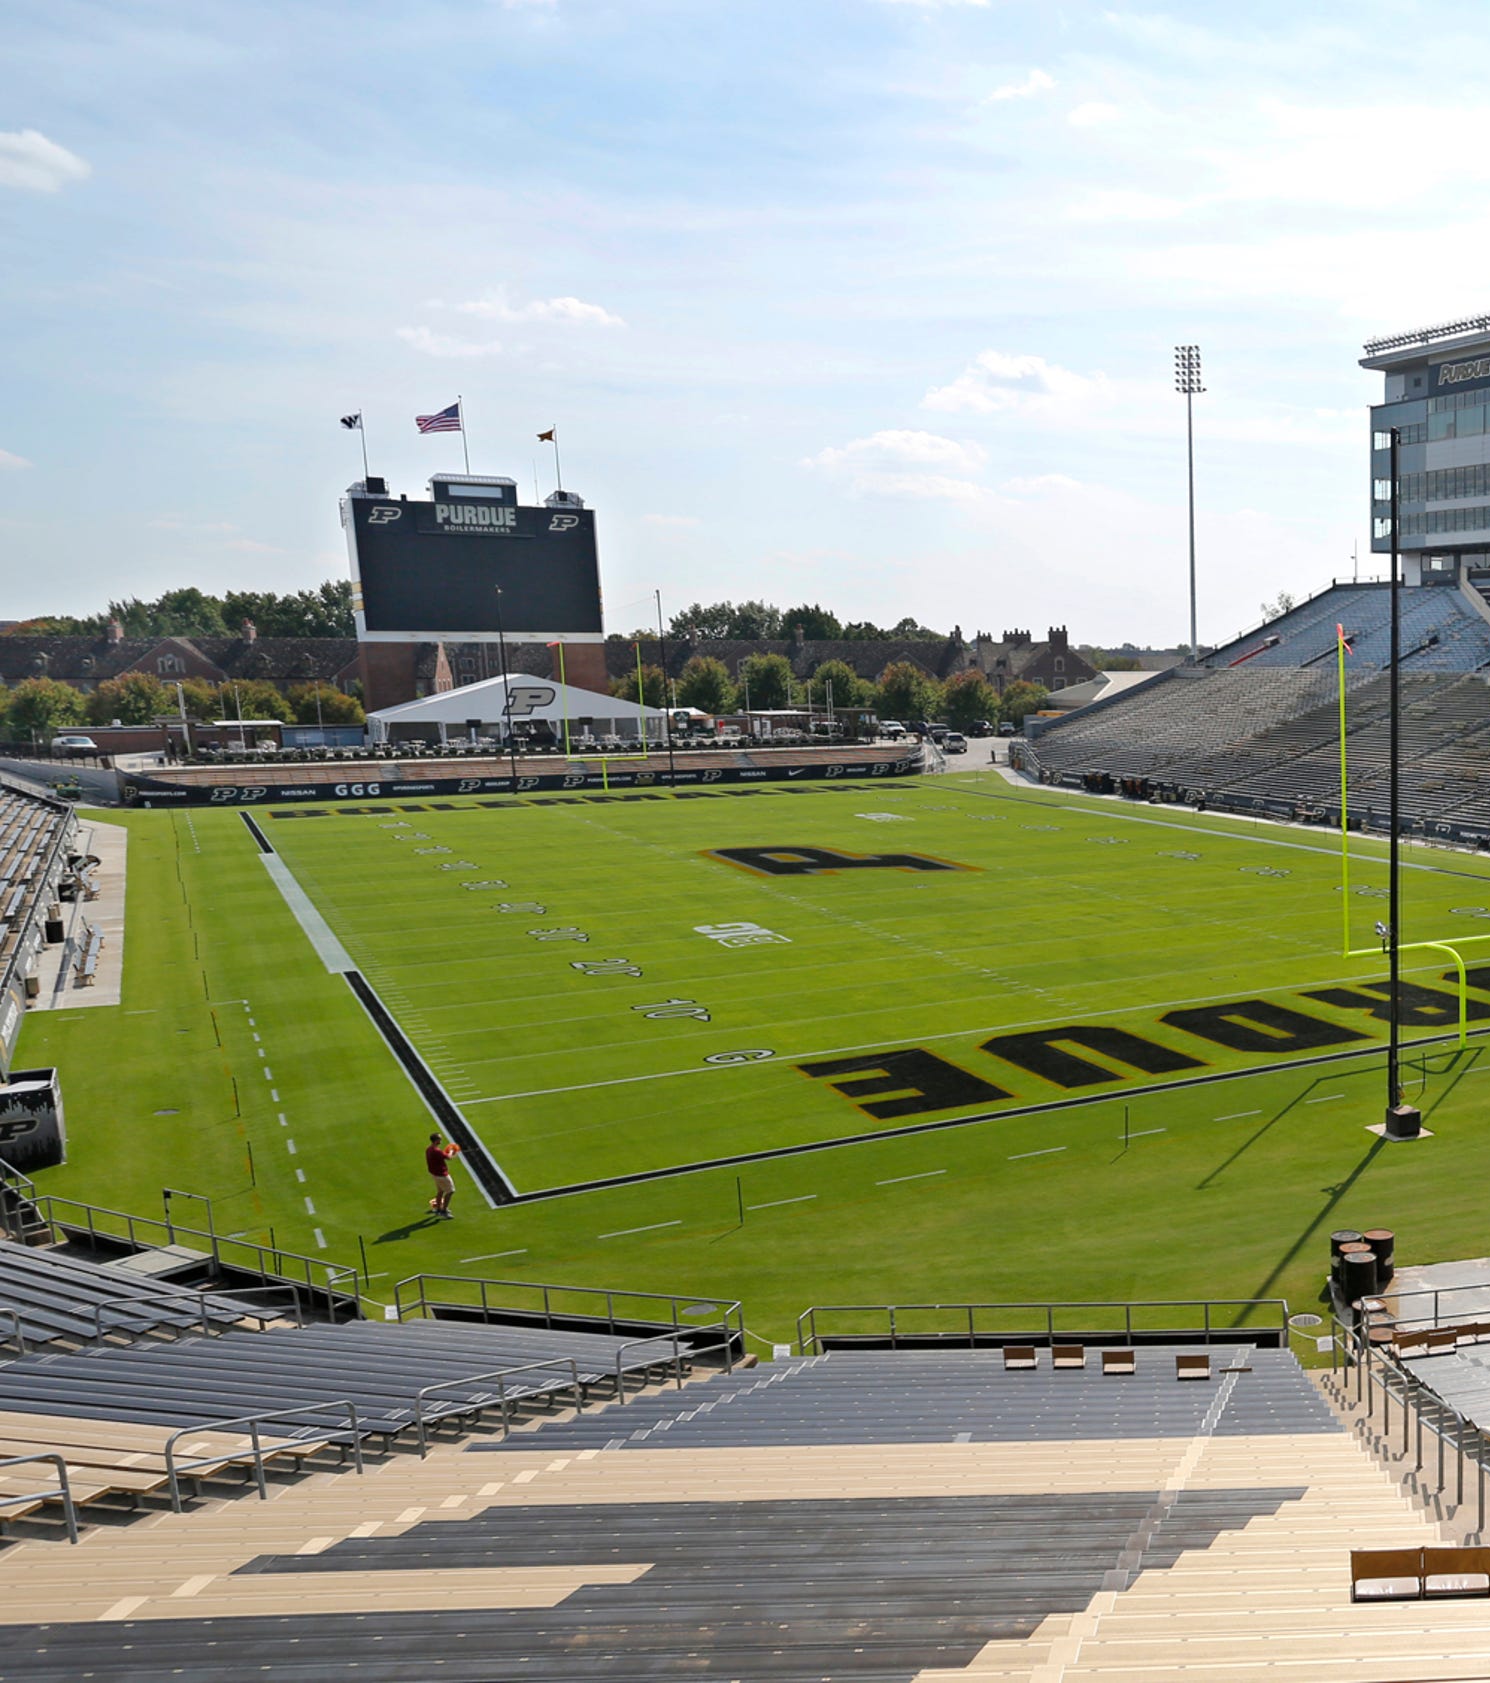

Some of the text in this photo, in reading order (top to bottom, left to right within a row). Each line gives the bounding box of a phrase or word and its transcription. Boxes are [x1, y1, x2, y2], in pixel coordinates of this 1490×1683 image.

[368, 506, 402, 524] P
[435, 503, 517, 527] PURDUE
[548, 513, 579, 532] P
[443, 524, 511, 534] BOILERMAKERS
[502, 687, 556, 716] P
[281, 789, 316, 797] NISSAN
